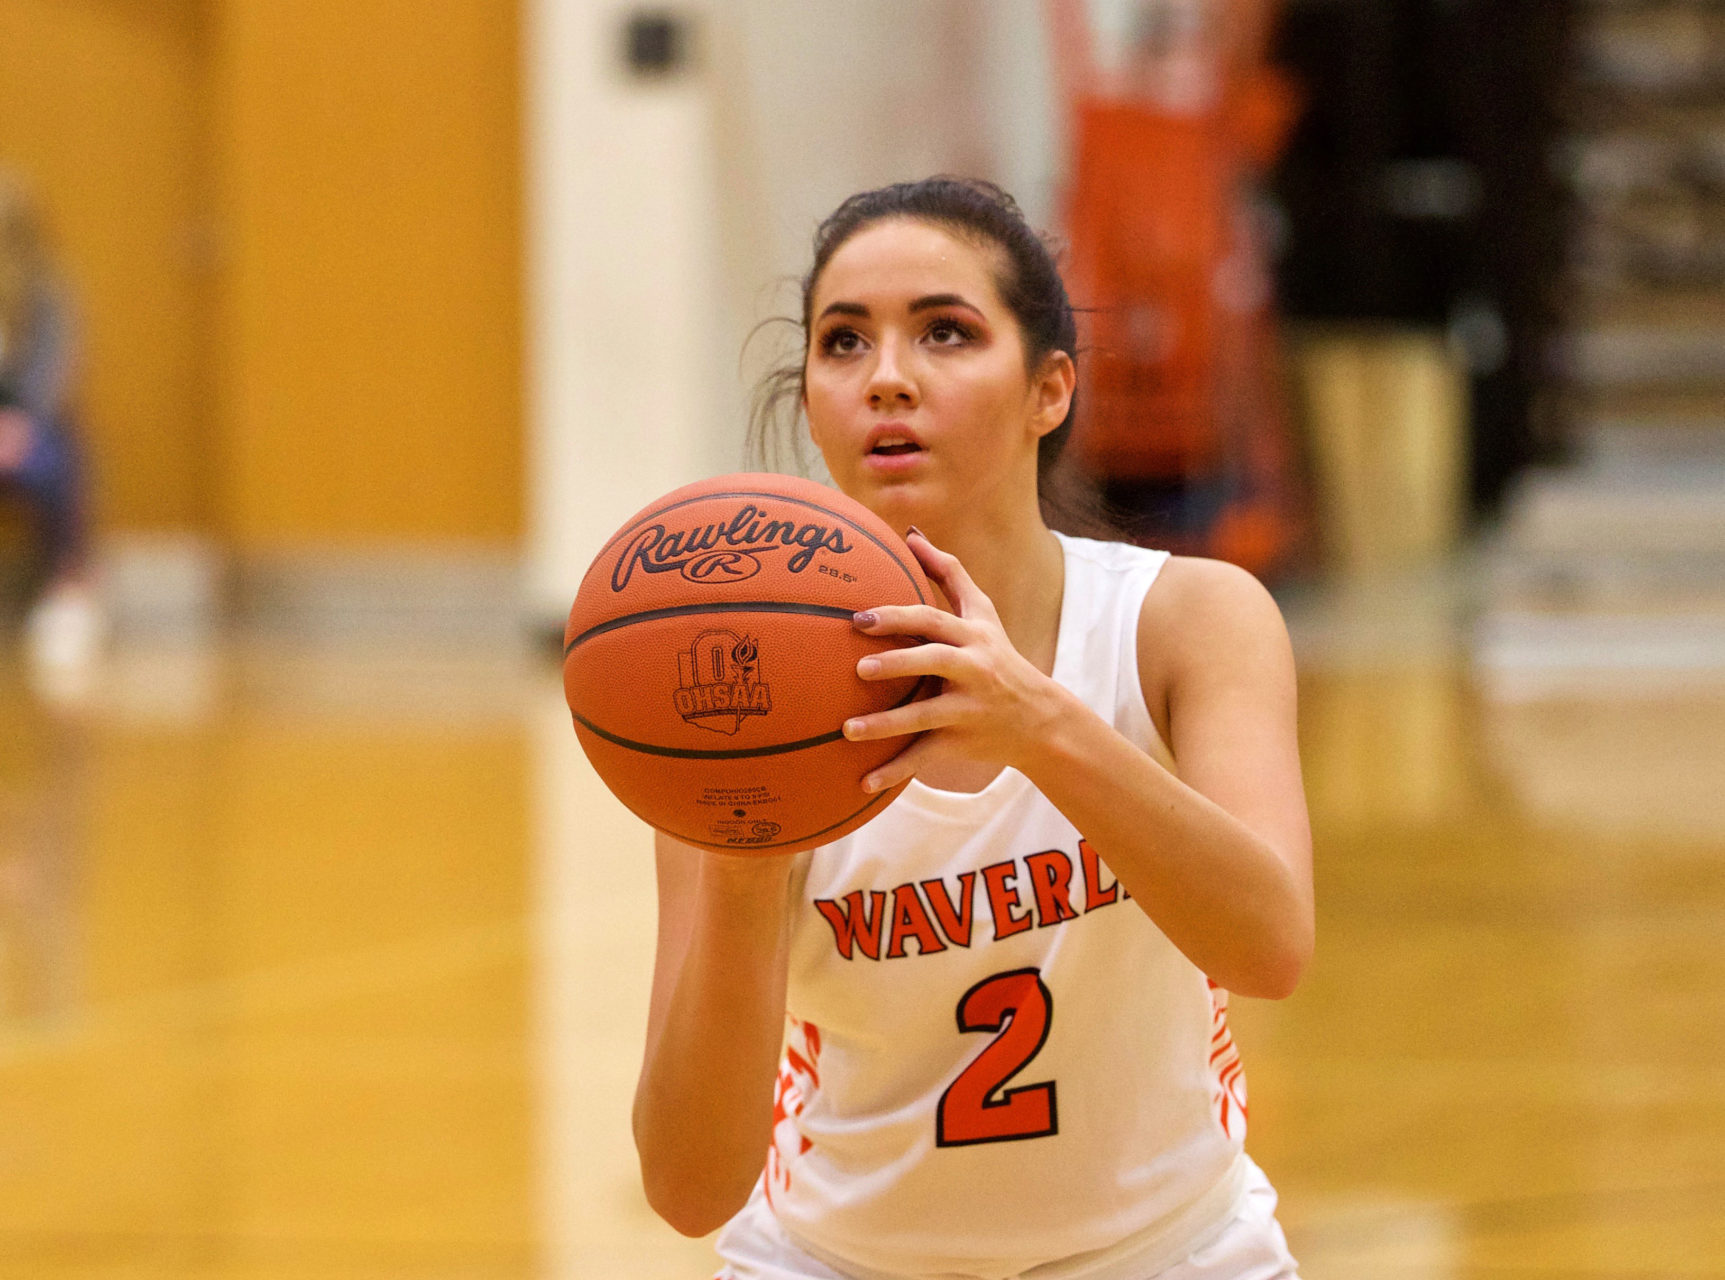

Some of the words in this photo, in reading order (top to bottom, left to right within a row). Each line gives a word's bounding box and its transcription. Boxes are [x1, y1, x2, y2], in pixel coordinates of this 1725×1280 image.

[611, 505, 853, 592] Rawlings
[818, 565, 858, 583] 28.5"
[672, 682, 773, 717] OHSAA
[814, 838, 1132, 961] WAVERL
[936, 966, 1058, 1147] 2
